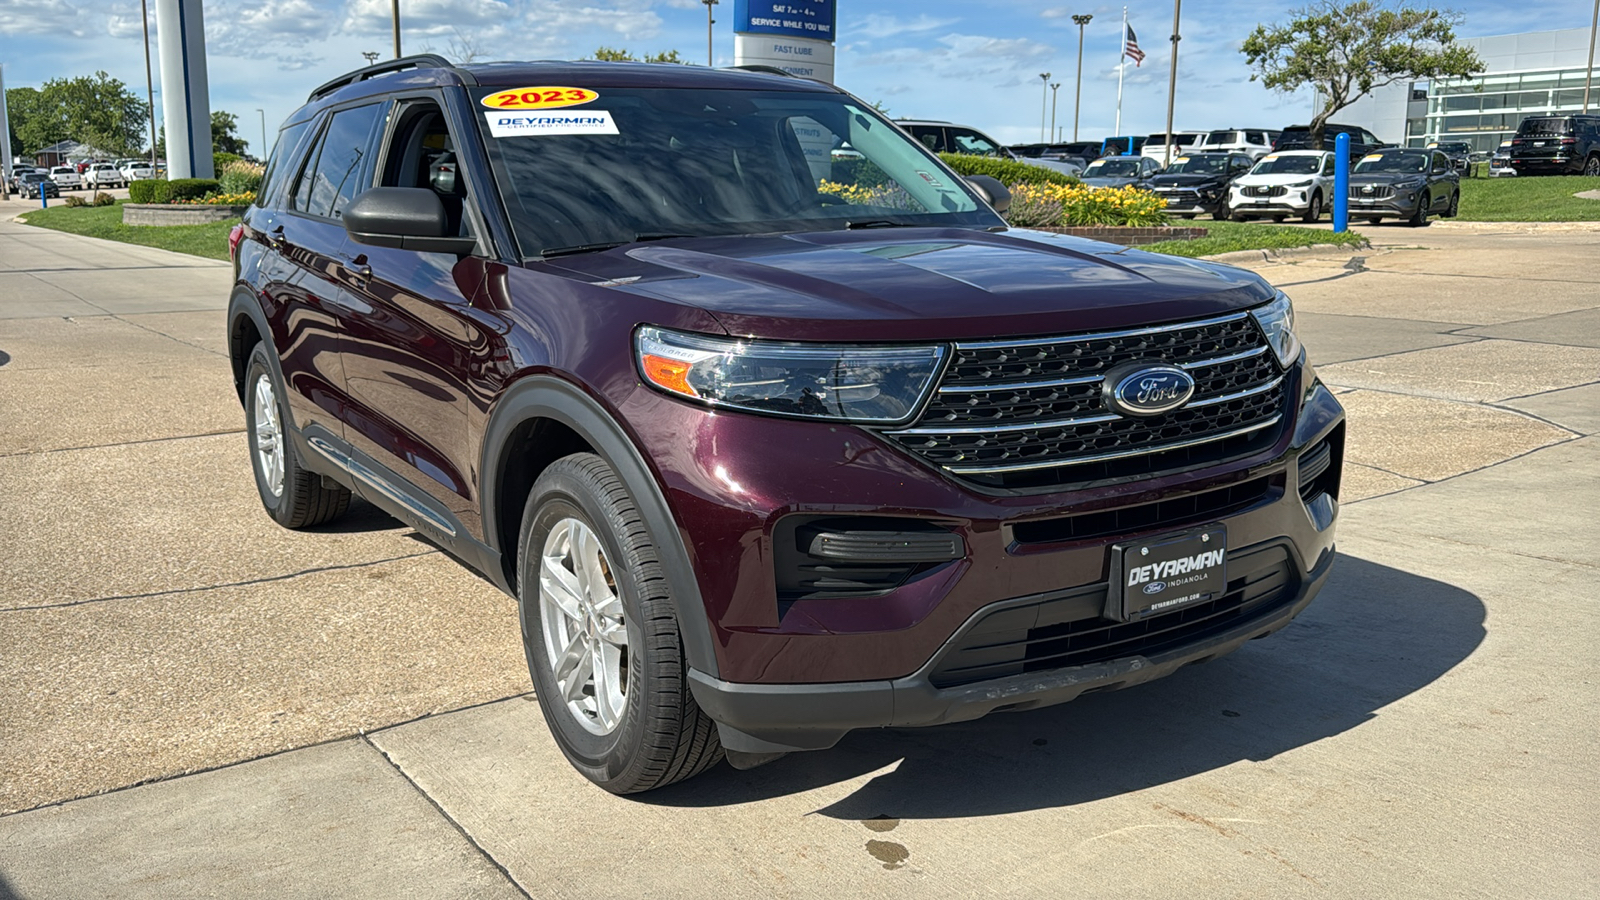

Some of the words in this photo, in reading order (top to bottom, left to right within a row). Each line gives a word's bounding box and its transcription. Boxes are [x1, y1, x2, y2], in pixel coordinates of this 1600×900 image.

[772, 4, 785, 13] SAT
[751, 17, 781, 27] SERVICE
[782, 20, 802, 29] WHILE
[804, 22, 817, 31] YOU
[818, 24, 831, 32] WAIT
[774, 44, 793, 54] FAST
[794, 46, 813, 55] LUBE
[498, 90, 587, 107] 2023
[498, 117, 605, 125] DEYARMAN
[1137, 376, 1179, 404] Ford
[1128, 547, 1225, 587] DEYARMAN
[1167, 573, 1209, 588] INDIANOLA
[1151, 592, 1200, 611] DEYARMANFORD.COM
